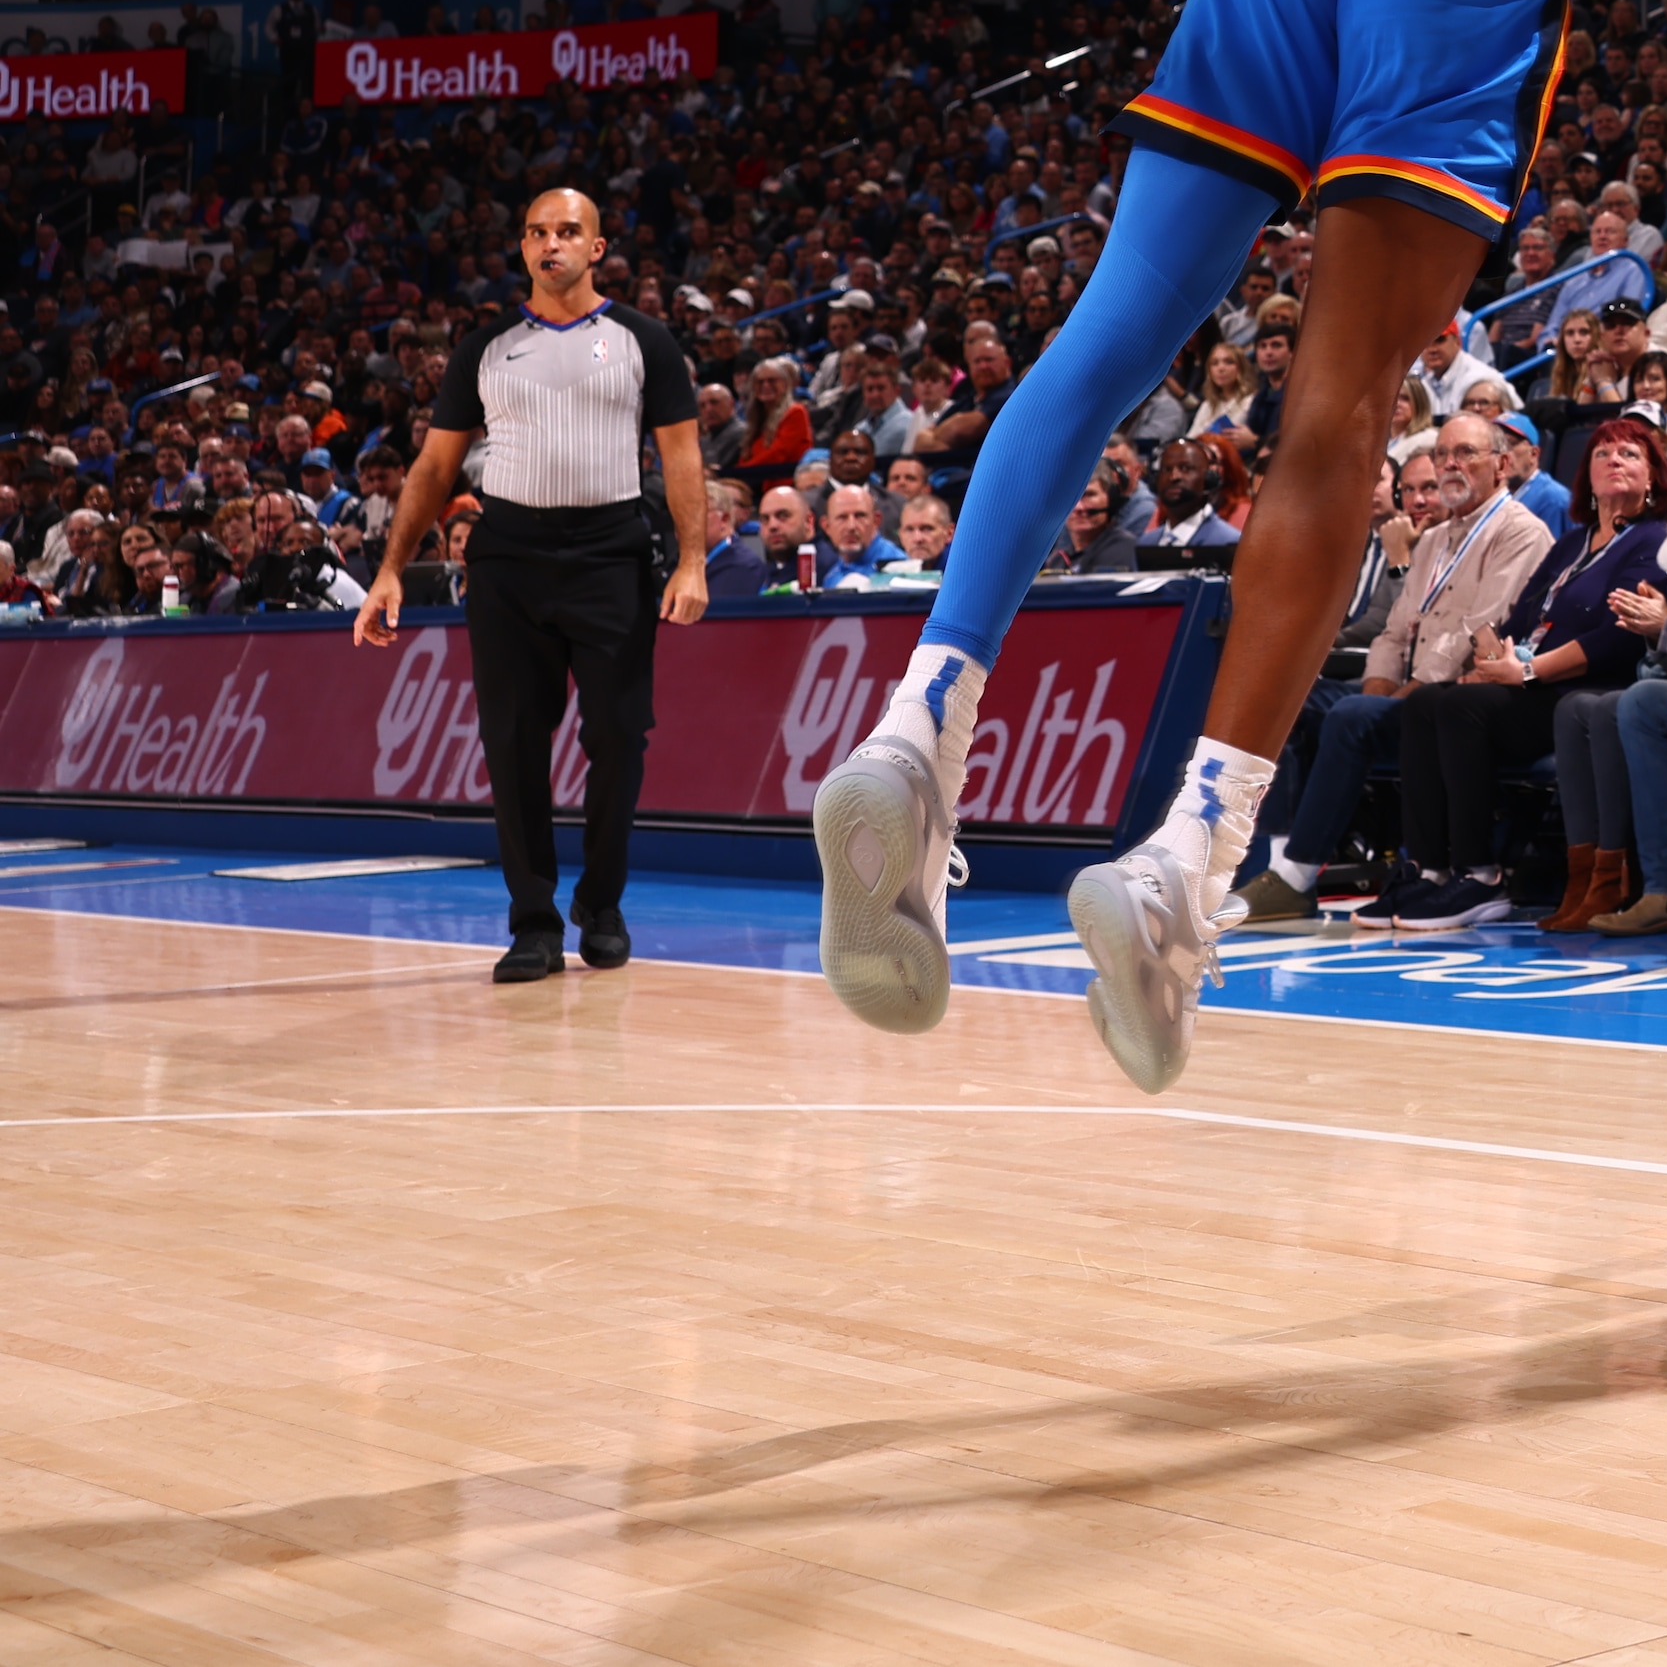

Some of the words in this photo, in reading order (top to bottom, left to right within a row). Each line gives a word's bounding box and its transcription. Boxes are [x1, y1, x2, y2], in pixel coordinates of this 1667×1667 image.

[25, 65, 149, 117] Health
[392, 48, 519, 100] Health
[105, 670, 270, 795] Health
